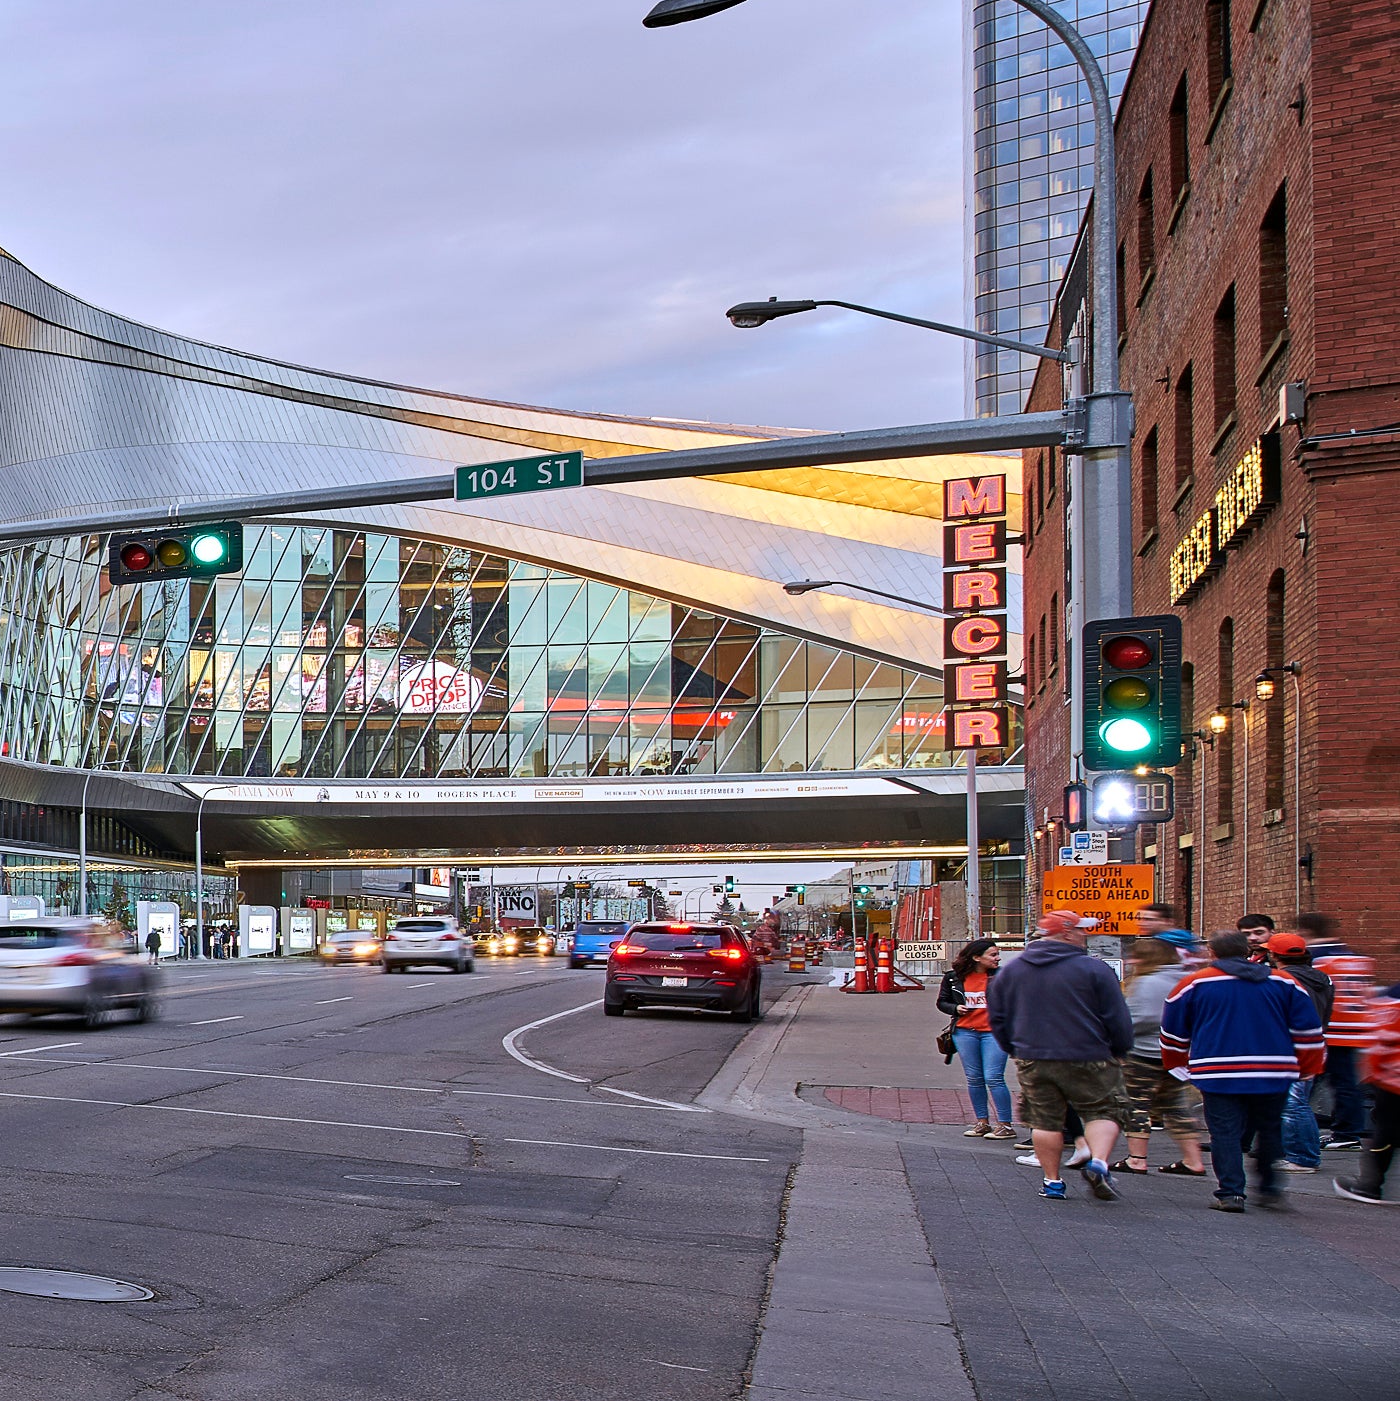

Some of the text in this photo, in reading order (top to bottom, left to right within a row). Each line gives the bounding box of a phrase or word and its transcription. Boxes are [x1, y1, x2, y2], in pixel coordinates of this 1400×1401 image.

[468, 459, 569, 493] 104 ST
[948, 474, 1003, 747] MERCER
[409, 673, 464, 692] PRICE
[411, 688, 467, 707] DROP
[267, 787, 295, 797] NOW
[355, 790, 379, 799] MAY
[383, 790, 390, 799] 9
[395, 791, 402, 799] &
[407, 790, 420, 799] 10
[437, 790, 478, 798] ROGERS
[483, 790, 517, 798] PLACE
[1084, 867, 1122, 877] SOUTH
[1071, 878, 1134, 889] SIDEWALK
[1056, 889, 1150, 900] CLOSED AHEAD
[1083, 911, 1111, 921] STOP
[1086, 921, 1119, 932] OPEN
[899, 944, 943, 952] SIDEWALK
[904, 951, 938, 959] CLOSED
